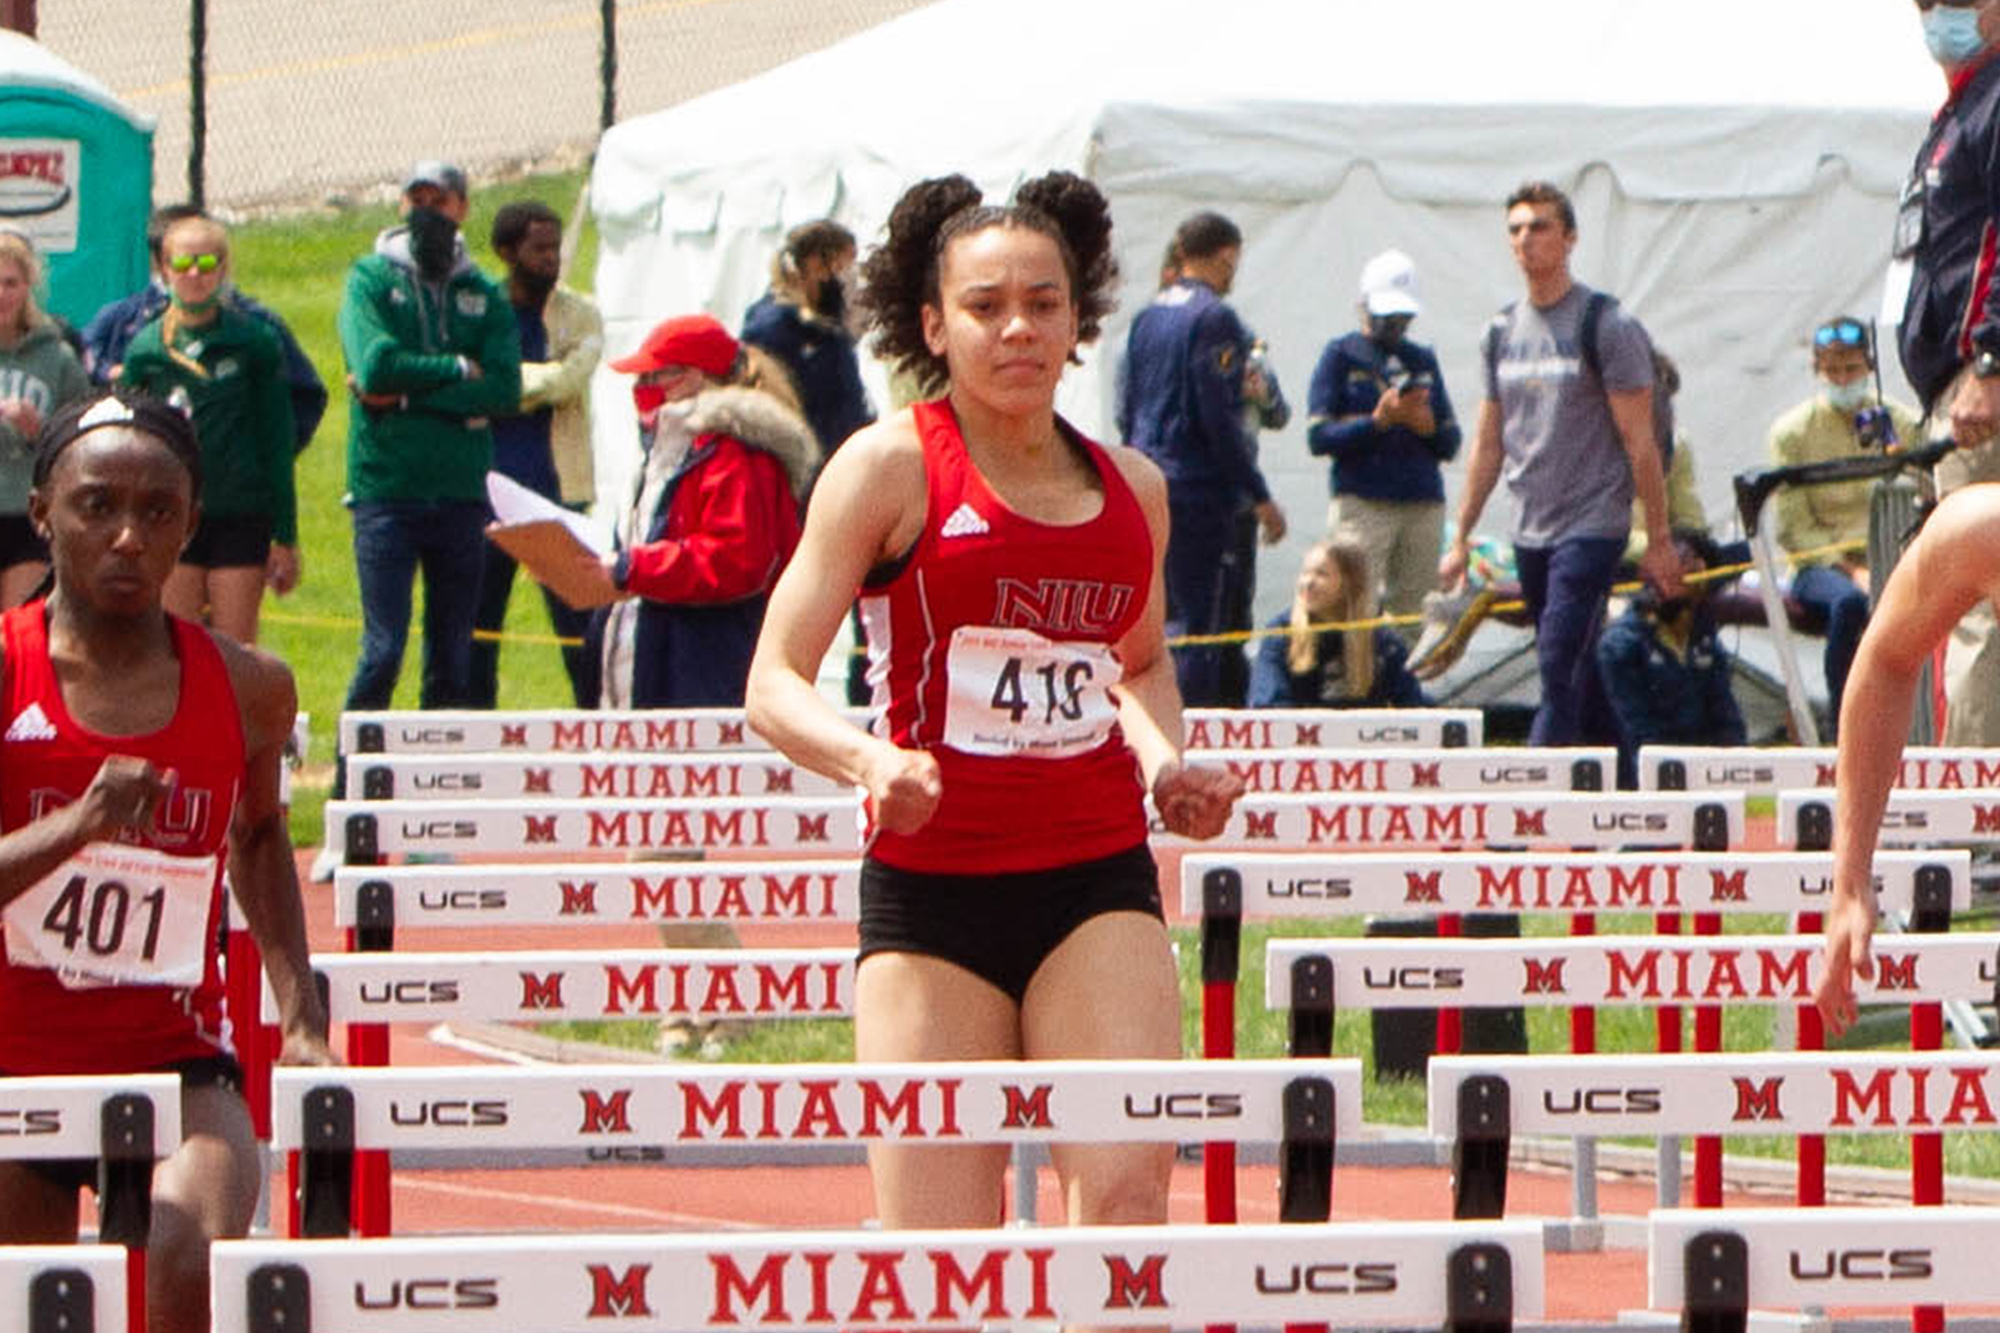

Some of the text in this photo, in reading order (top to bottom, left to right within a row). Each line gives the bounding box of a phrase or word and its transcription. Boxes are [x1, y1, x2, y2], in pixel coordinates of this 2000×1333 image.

[992, 577, 1134, 632] NIU
[402, 719, 743, 752] UCS M MIAMI M
[1185, 720, 1272, 749] AMI
[1296, 724, 1320, 746] M
[414, 764, 793, 798] UCS M MIAMI M
[1226, 760, 1548, 790] MIAMI M UCS
[1706, 768, 1773, 784] UCS
[1898, 760, 2000, 789] IAM
[402, 809, 828, 848] UCS M MIAMI M
[1245, 804, 1667, 843] M MIAMI M UCS
[1881, 812, 1928, 828] CS
[420, 874, 837, 919] UCS M MIAMI
[1267, 865, 1747, 908] UCS M MIAMI M
[43, 873, 165, 961] 401
[360, 964, 841, 1017] UCS M MIAMI
[1364, 950, 1919, 998] UCS M MIAM M
[391, 1079, 1242, 1139] UCS M MIAMI M UCS
[1544, 1089, 1661, 1114] UCS
[1733, 1077, 1783, 1122] M
[0, 1111, 62, 1135] CS
[587, 1146, 665, 1161] UCS
[1790, 1250, 1932, 1280] UCS
[355, 1249, 1397, 1324] UCS M MIAMI M UCS
